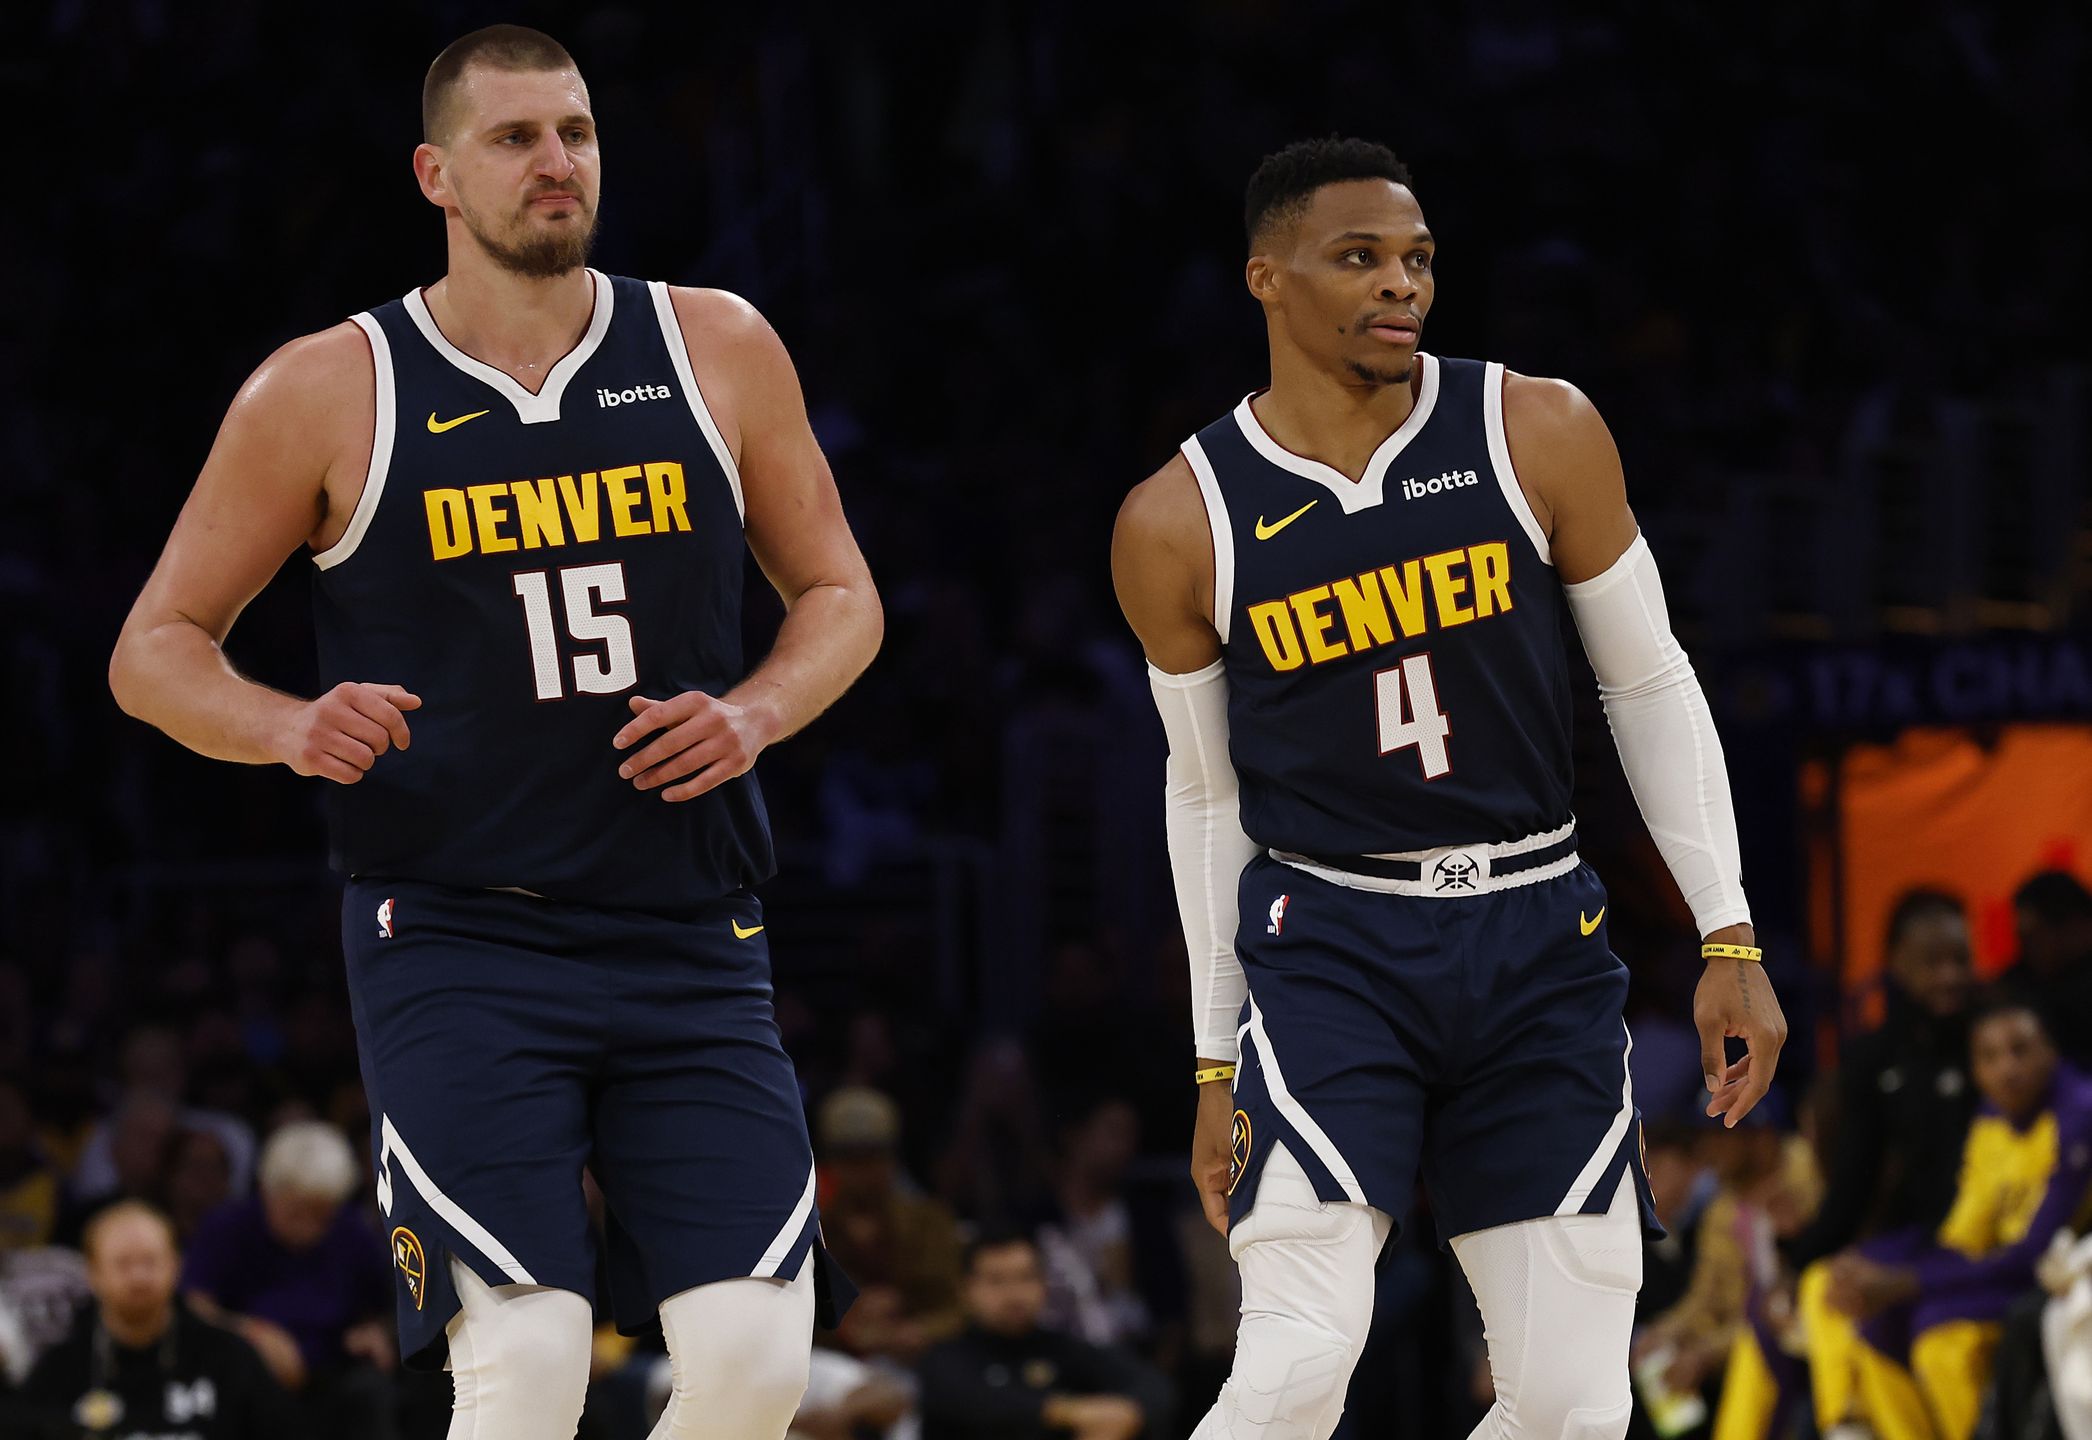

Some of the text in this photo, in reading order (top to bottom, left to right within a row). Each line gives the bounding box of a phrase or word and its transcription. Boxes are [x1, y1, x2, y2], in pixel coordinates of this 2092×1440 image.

[597, 383, 672, 408] ibotta
[423, 460, 693, 562] DENVER
[1402, 470, 1479, 500] ibotta
[512, 560, 638, 701] 15
[1247, 540, 1513, 672] DENVER
[1373, 651, 1452, 783] 4
